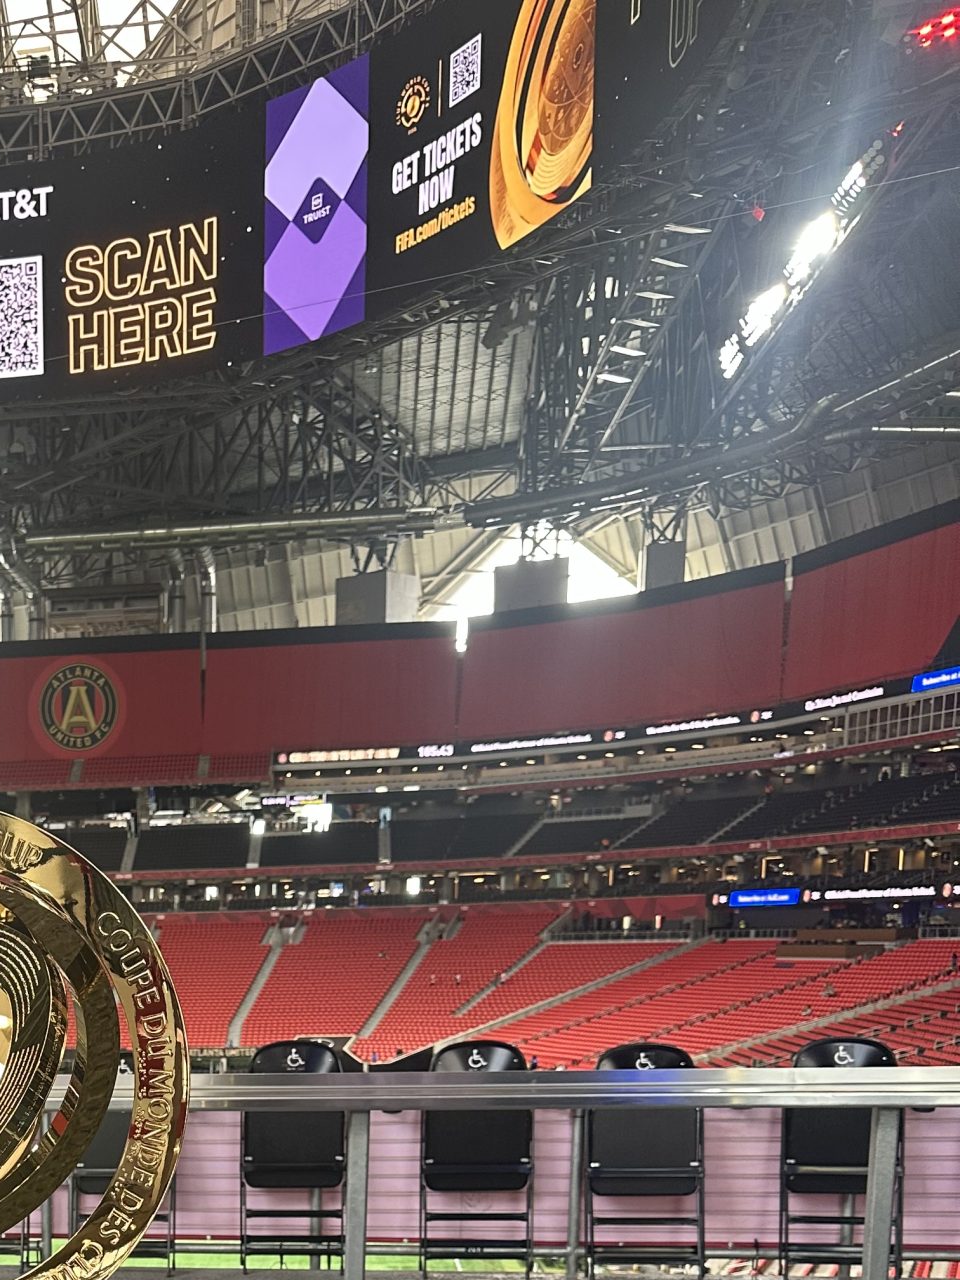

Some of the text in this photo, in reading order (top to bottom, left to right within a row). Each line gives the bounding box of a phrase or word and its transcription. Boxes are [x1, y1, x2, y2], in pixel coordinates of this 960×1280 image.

[392, 112, 482, 194] GET TICKETS
[303, 205, 331, 224] TRUIST
[419, 165, 455, 216] NOW
[395, 196, 476, 254] FIFA.com/tickets
[65, 217, 217, 306] SCAN
[68, 289, 217, 374] HERE
[51, 666, 106, 688] ATLANTA
[49, 723, 109, 747] UNITED FC
[97, 911, 161, 1009] COUPE
[142, 1012, 173, 1060] DU
[138, 1067, 174, 1190] MONDE
[100, 1194, 145, 1246] DES
